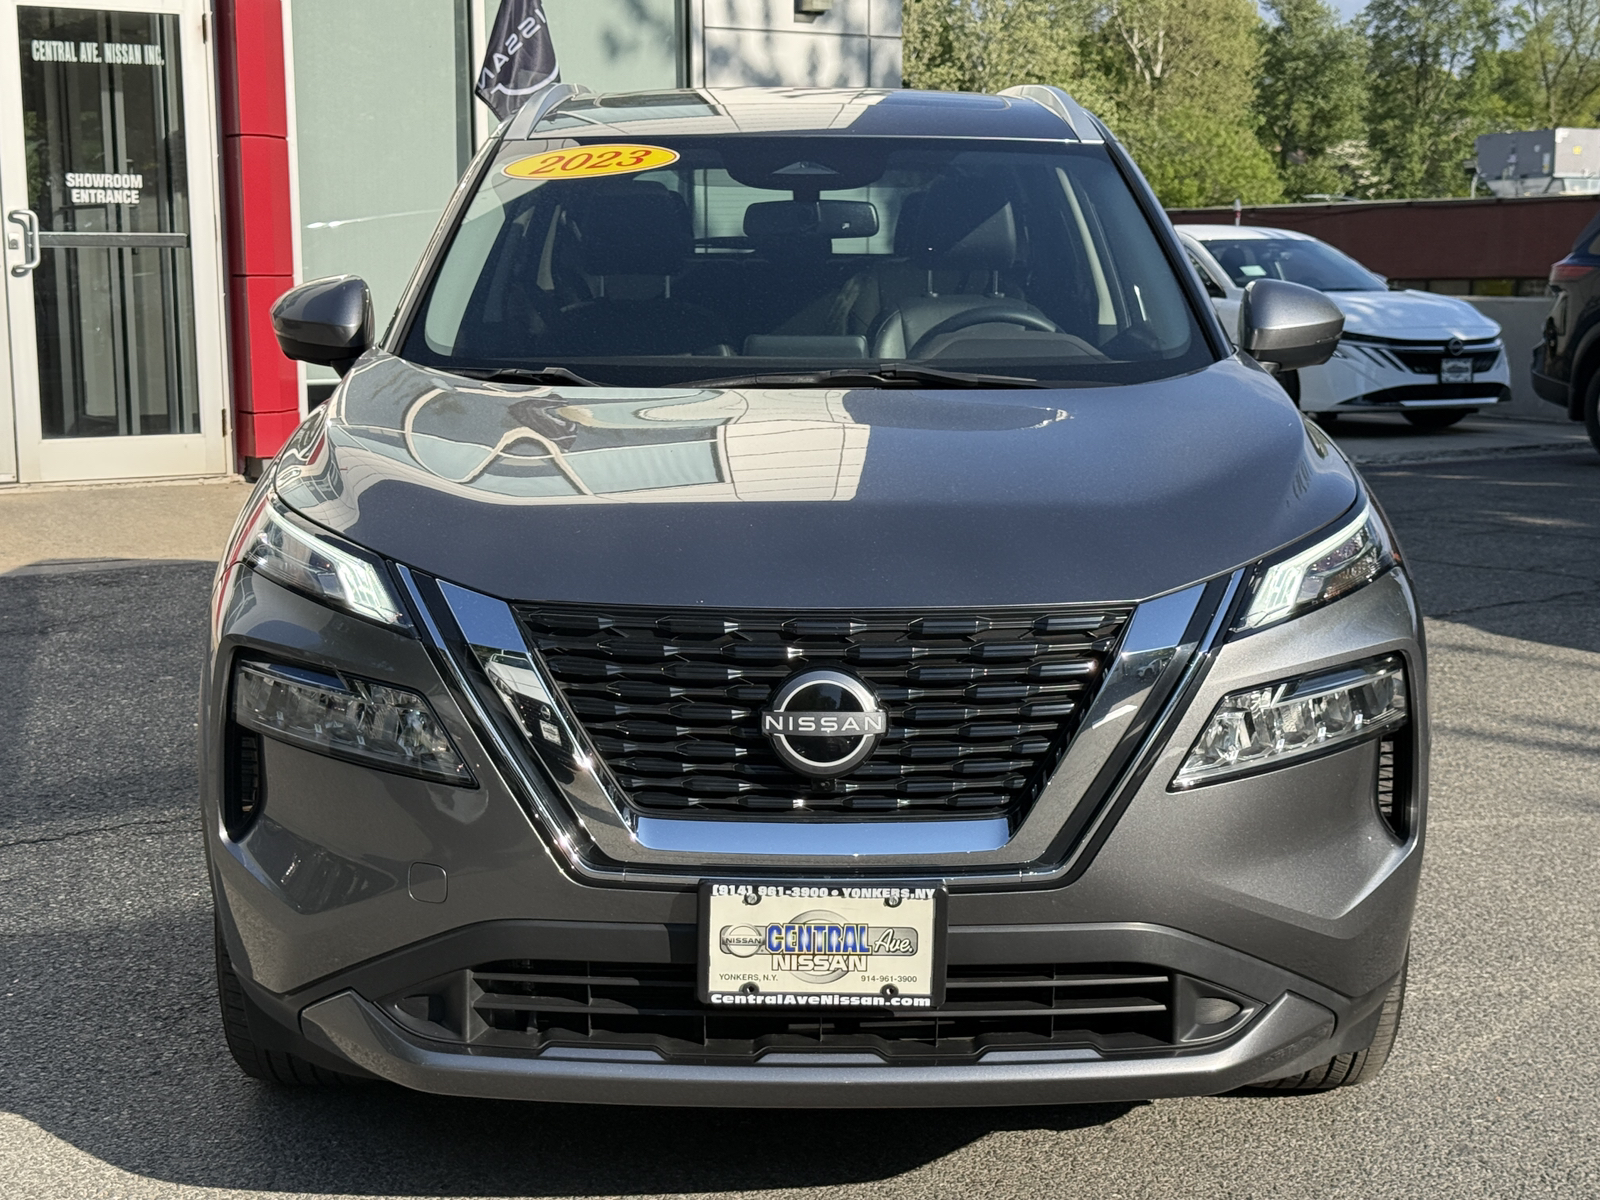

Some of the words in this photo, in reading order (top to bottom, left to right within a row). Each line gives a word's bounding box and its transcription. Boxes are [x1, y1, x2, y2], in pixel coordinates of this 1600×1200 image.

[31, 39, 78, 62] CENTRAL
[79, 41, 102, 63] AVE.
[103, 42, 142, 65] NISSAN
[143, 44, 165, 66] INC.
[528, 149, 653, 176] 2023
[65, 172, 143, 189] SHOWROOM
[71, 188, 140, 204] ENTRANCE
[765, 715, 882, 732] NISSAN
[757, 886, 829, 897] 961-3900
[765, 923, 873, 955] CENTRAL
[874, 928, 915, 953] Ave.
[771, 954, 868, 972] NISSAN
[719, 973, 761, 982] YONKERS,
[860, 975, 918, 983] 914-961-3900
[710, 993, 931, 1007] CentralAveNissan.com
